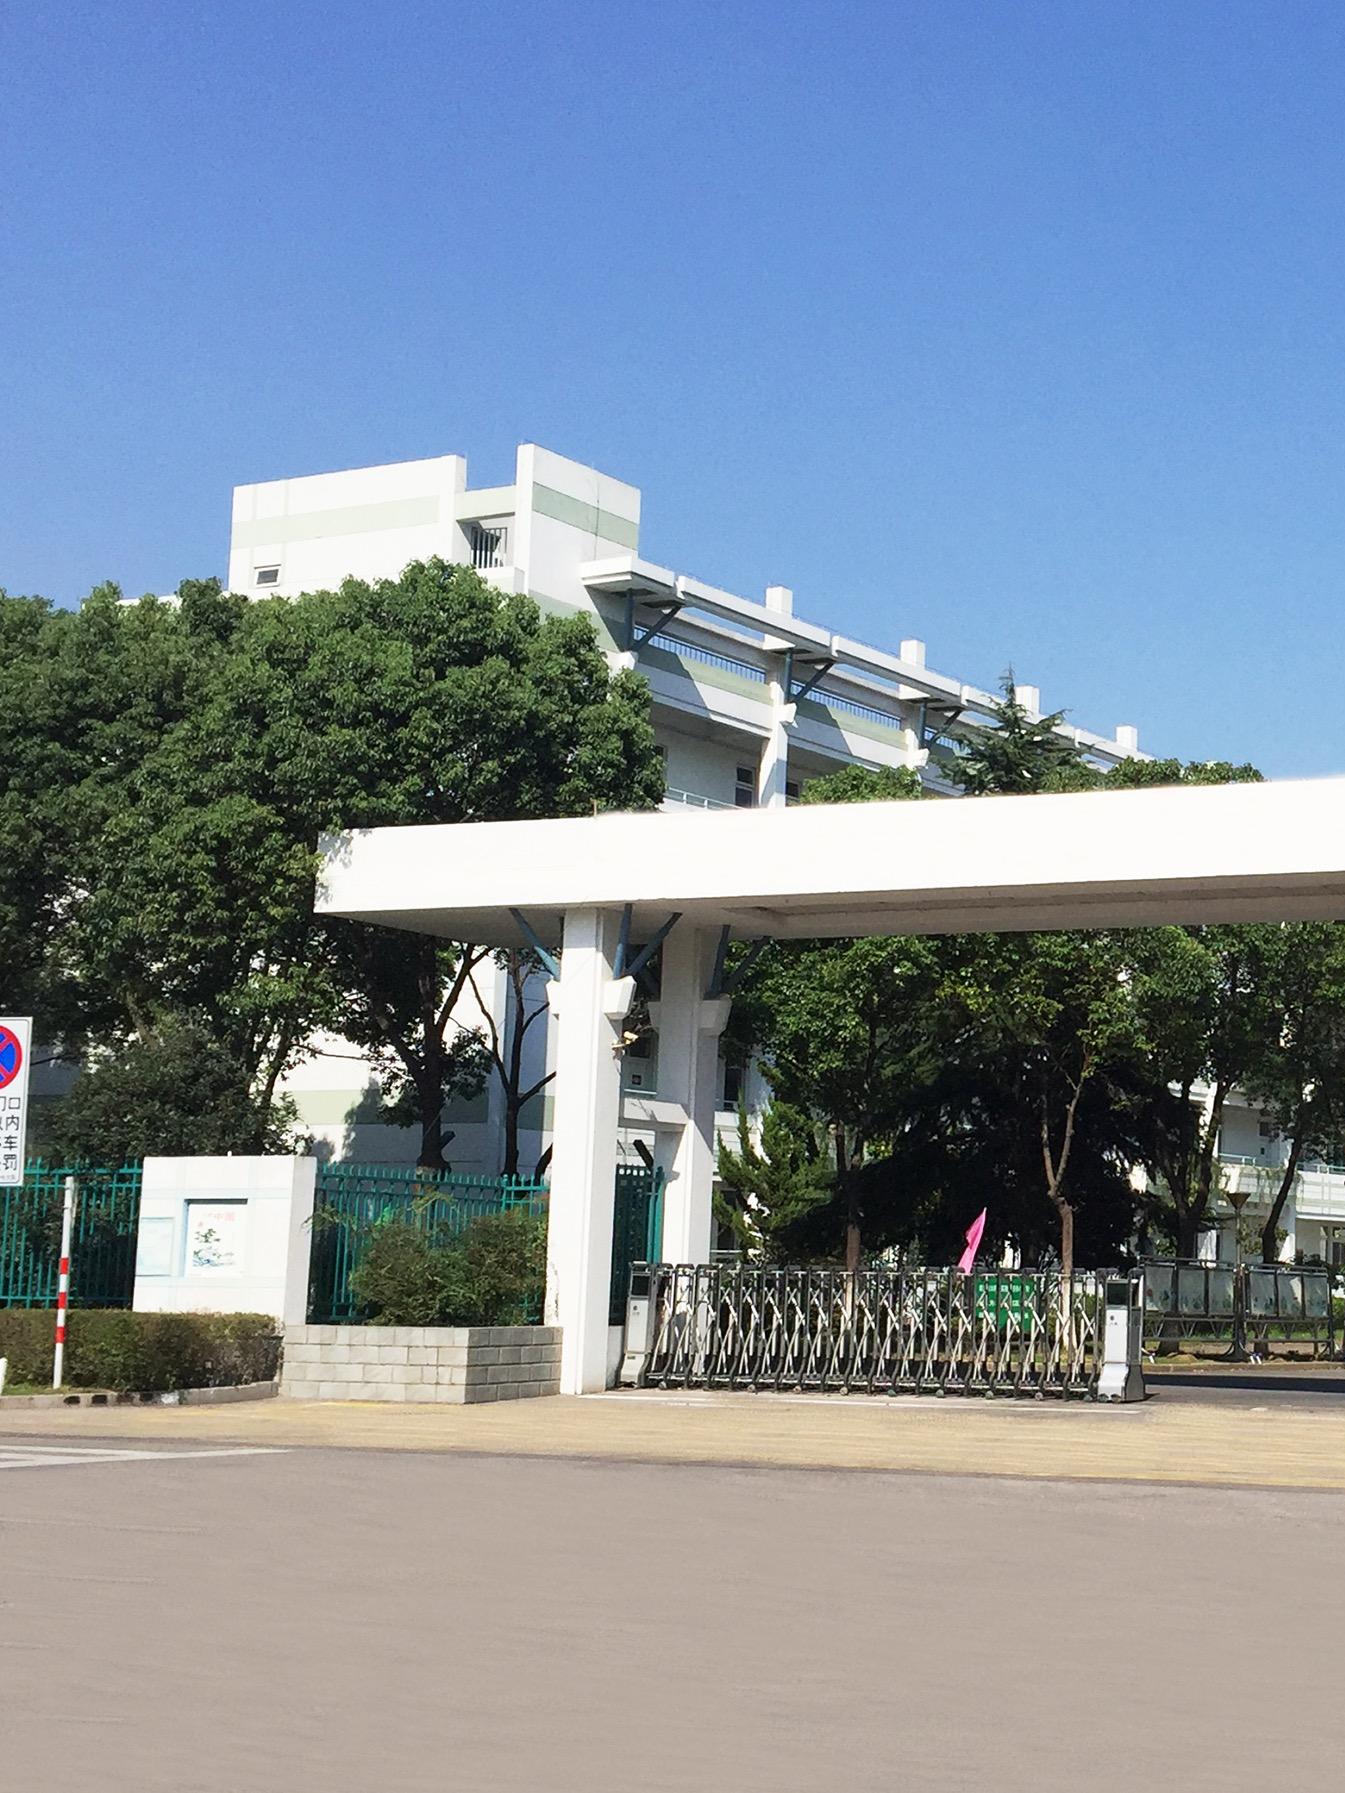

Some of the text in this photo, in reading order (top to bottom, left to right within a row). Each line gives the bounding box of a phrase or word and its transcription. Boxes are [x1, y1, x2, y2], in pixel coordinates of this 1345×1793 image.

[0, 1115, 19, 1131] 内
[0, 1135, 18, 1150] 车
[0, 1154, 17, 1171] 罚
